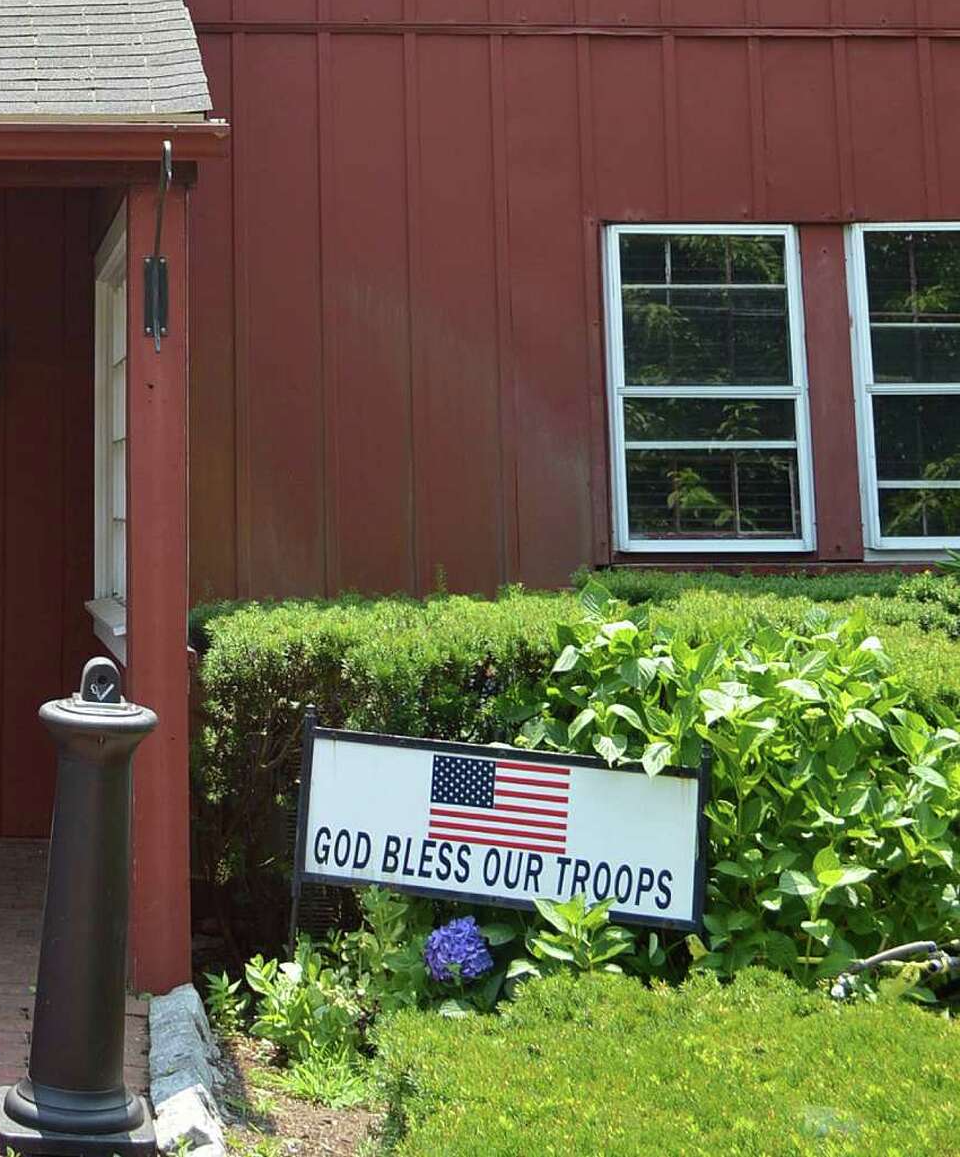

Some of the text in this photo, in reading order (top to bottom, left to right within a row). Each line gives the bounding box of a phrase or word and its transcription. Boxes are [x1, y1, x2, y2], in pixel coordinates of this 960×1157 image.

[313, 826, 673, 910] GOD BLESS OUR TROOPS
